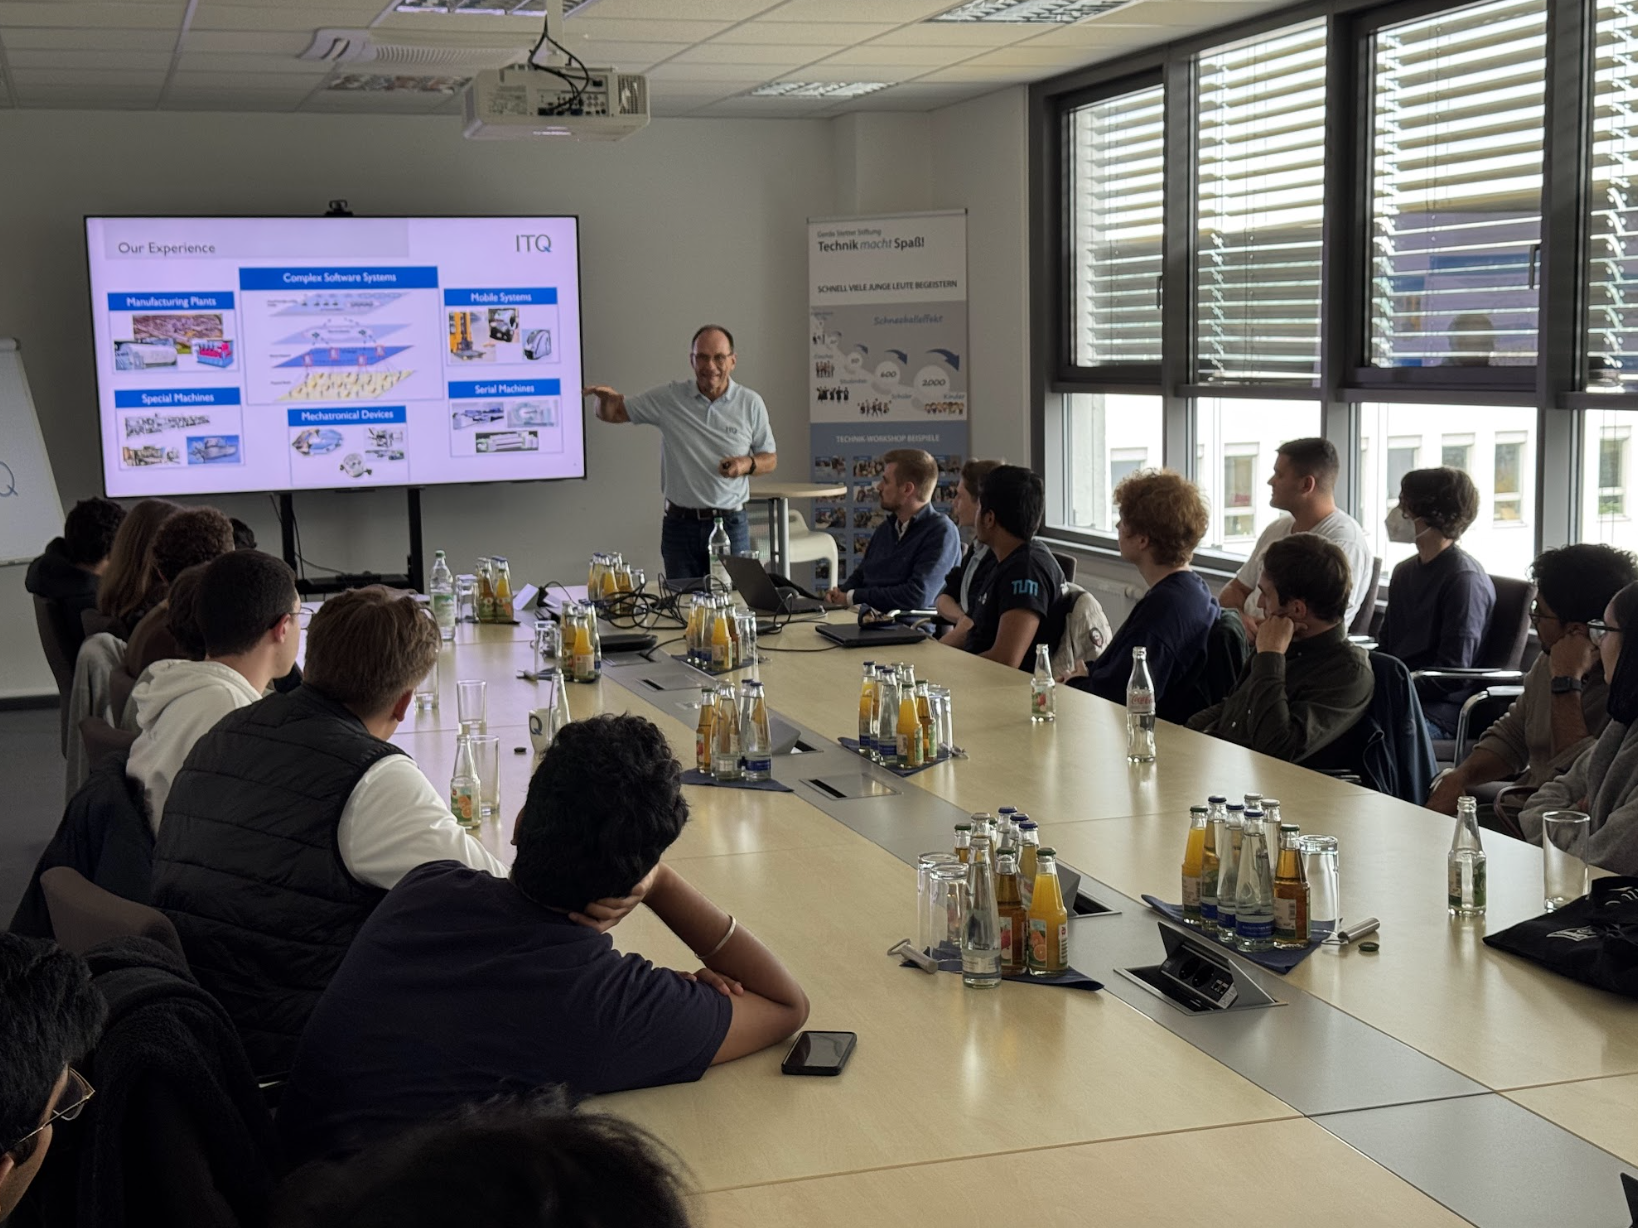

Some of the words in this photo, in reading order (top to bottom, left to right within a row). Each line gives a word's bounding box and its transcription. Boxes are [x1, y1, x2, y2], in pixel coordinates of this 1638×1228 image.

[118, 242, 144, 254] Our
[149, 242, 216, 256] Experience
[516, 234, 551, 253] ITQ
[818, 239, 859, 252] Technik
[894, 236, 925, 251] Spaß!
[283, 272, 322, 285] Complex
[324, 272, 361, 282] Software
[363, 272, 397, 284] Systems
[817, 284, 847, 293] SCHNELL
[848, 283, 867, 292] VIELE
[869, 282, 891, 291] JUNGE
[892, 281, 913, 290] LEUTE
[915, 280, 958, 289] BEGEISTERN
[126, 296, 189, 309] Manufacturing
[190, 296, 217, 306] Plants
[470, 292, 498, 303] Mobile
[499, 292, 532, 304] Systems
[474, 384, 497, 395] Serial
[498, 383, 535, 393] Machines
[141, 393, 173, 405] Special
[174, 392, 215, 403] Machines
[301, 410, 359, 421] Mechatronical
[360, 409, 394, 420] Devices
[1011, 579, 1038, 596] TUM
